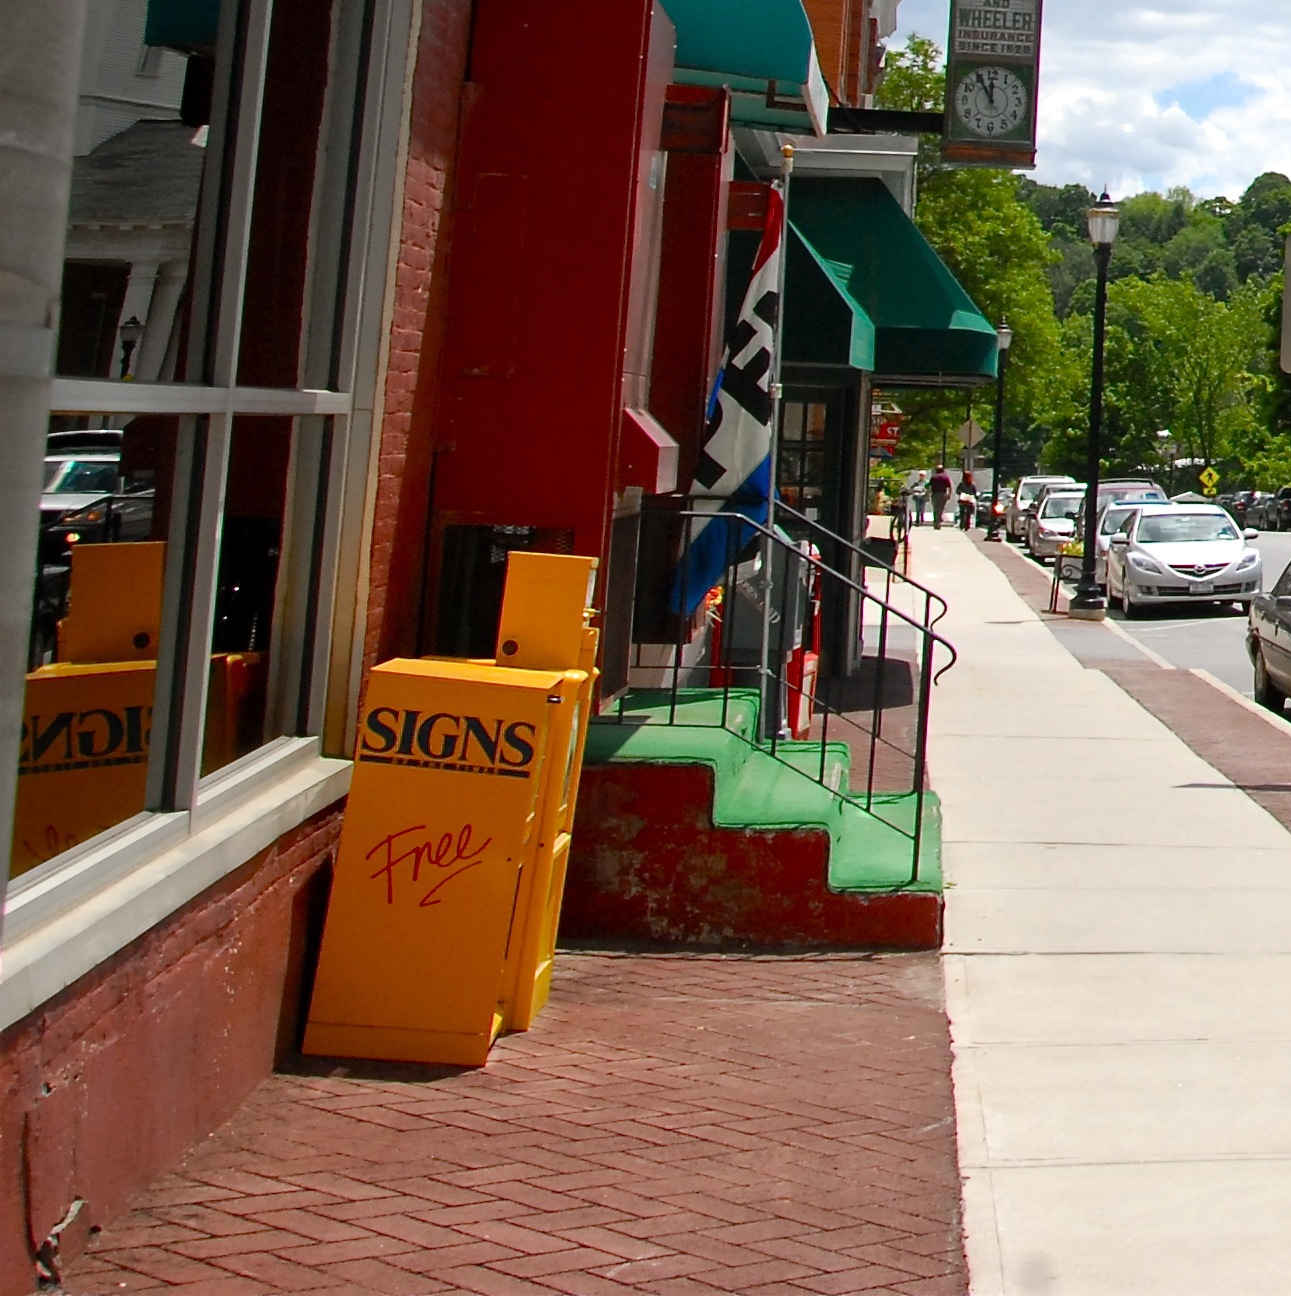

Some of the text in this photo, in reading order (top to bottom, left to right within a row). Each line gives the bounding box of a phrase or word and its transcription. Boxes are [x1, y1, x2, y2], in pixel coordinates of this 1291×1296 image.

[958, 8, 1033, 31] WHEELER
[958, 30, 1034, 43] INSURANCE
[958, 41, 998, 53] SINCE
[360, 706, 536, 768] SIGNS
[365, 823, 491, 904] Free
